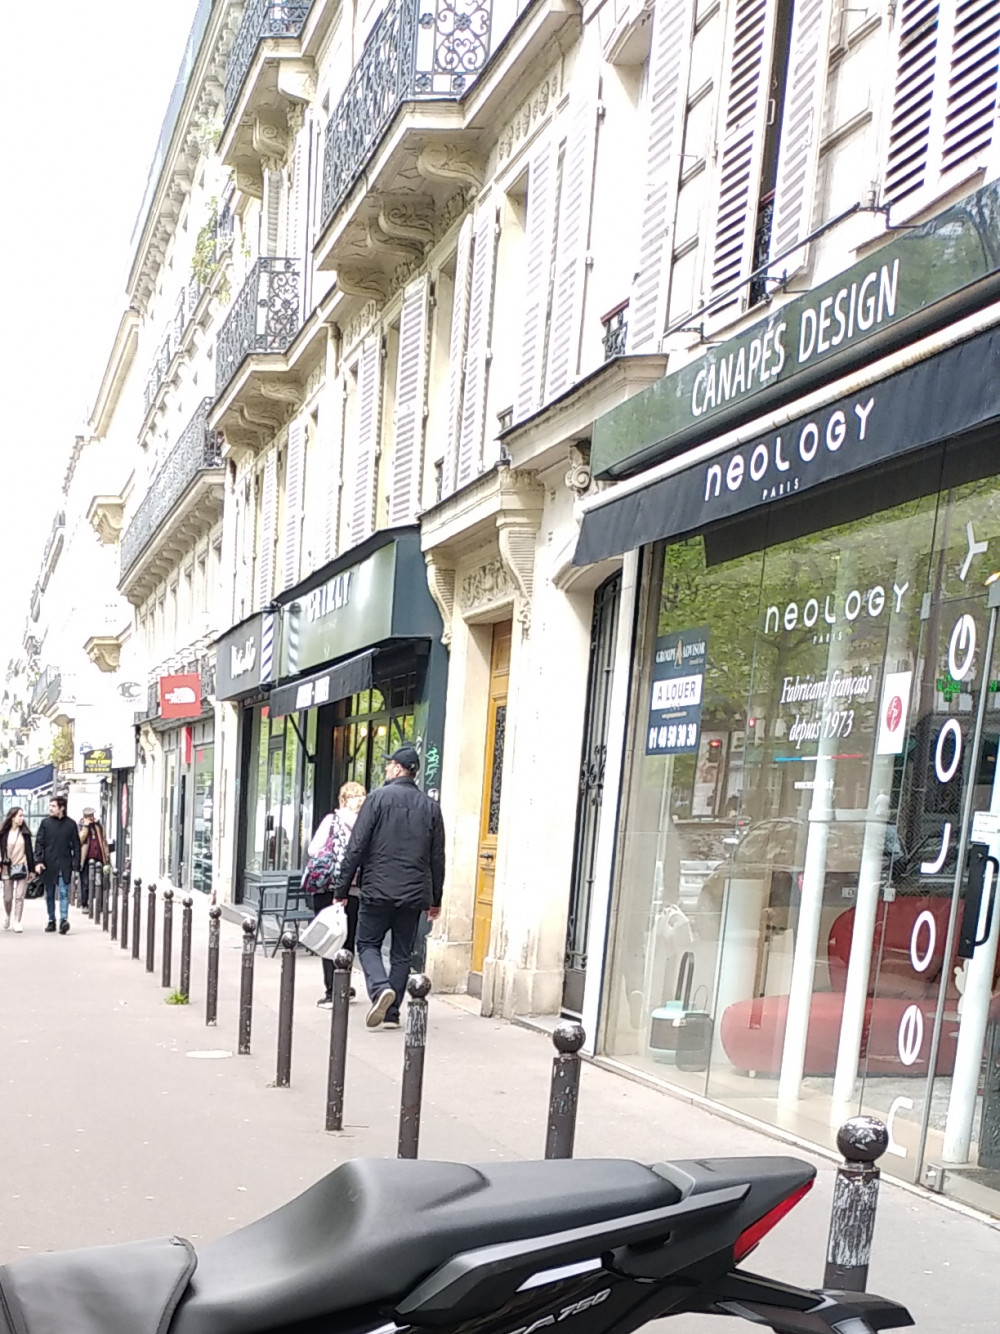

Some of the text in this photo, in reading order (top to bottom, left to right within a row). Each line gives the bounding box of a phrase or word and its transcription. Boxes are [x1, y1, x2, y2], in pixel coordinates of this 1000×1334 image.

[691, 259, 901, 417] CANAPÉS DESIGN
[762, 478, 801, 500] PARIS
[657, 681, 696, 702] A LOUER
[781, 667, 873, 706] Fabricant français
[789, 710, 855, 750] depuis 1973
[556, 1287, 611, 1323] 750
